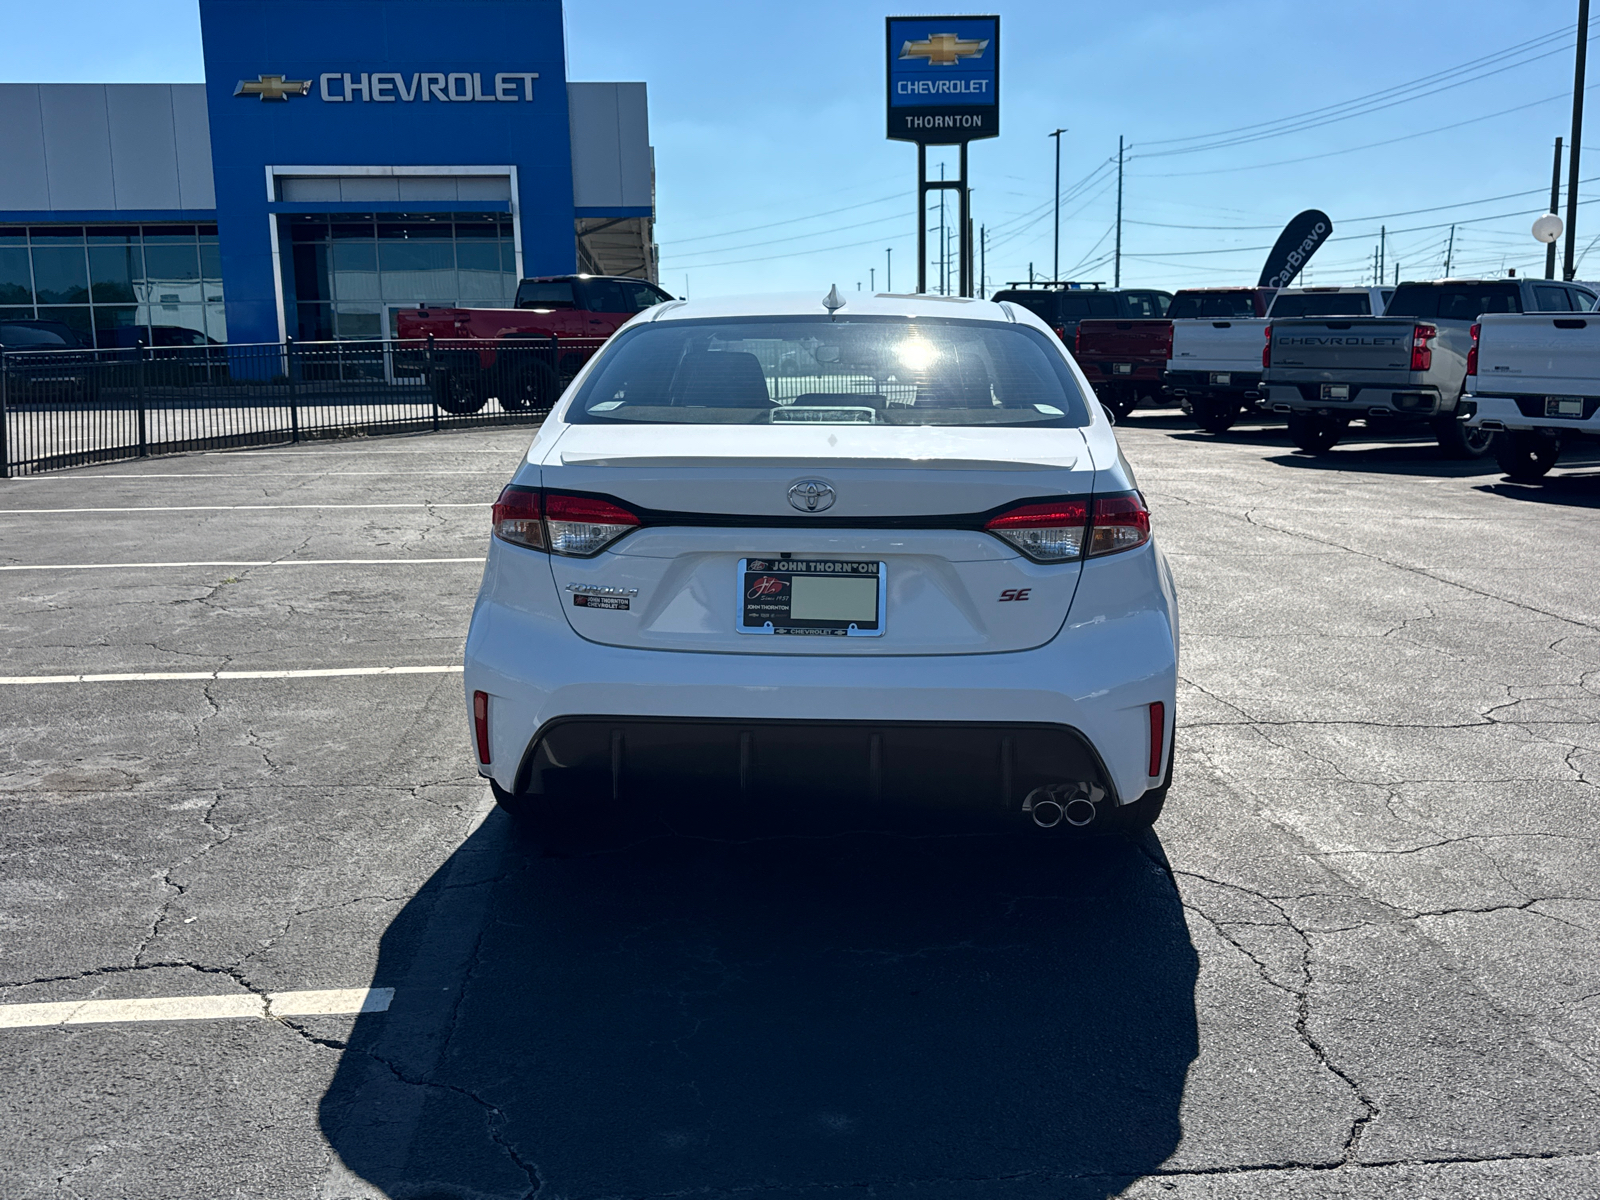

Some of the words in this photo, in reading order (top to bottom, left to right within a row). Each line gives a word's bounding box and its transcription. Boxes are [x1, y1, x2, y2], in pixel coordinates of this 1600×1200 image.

[320, 72, 539, 102] CHEVROLET
[897, 79, 989, 94] CHEVROLET
[905, 115, 982, 128] THORNTON
[1268, 222, 1326, 288] CarBravo
[1279, 337, 1400, 346] CHEVROLET
[772, 561, 807, 571] JOHN
[998, 588, 1032, 602] SE
